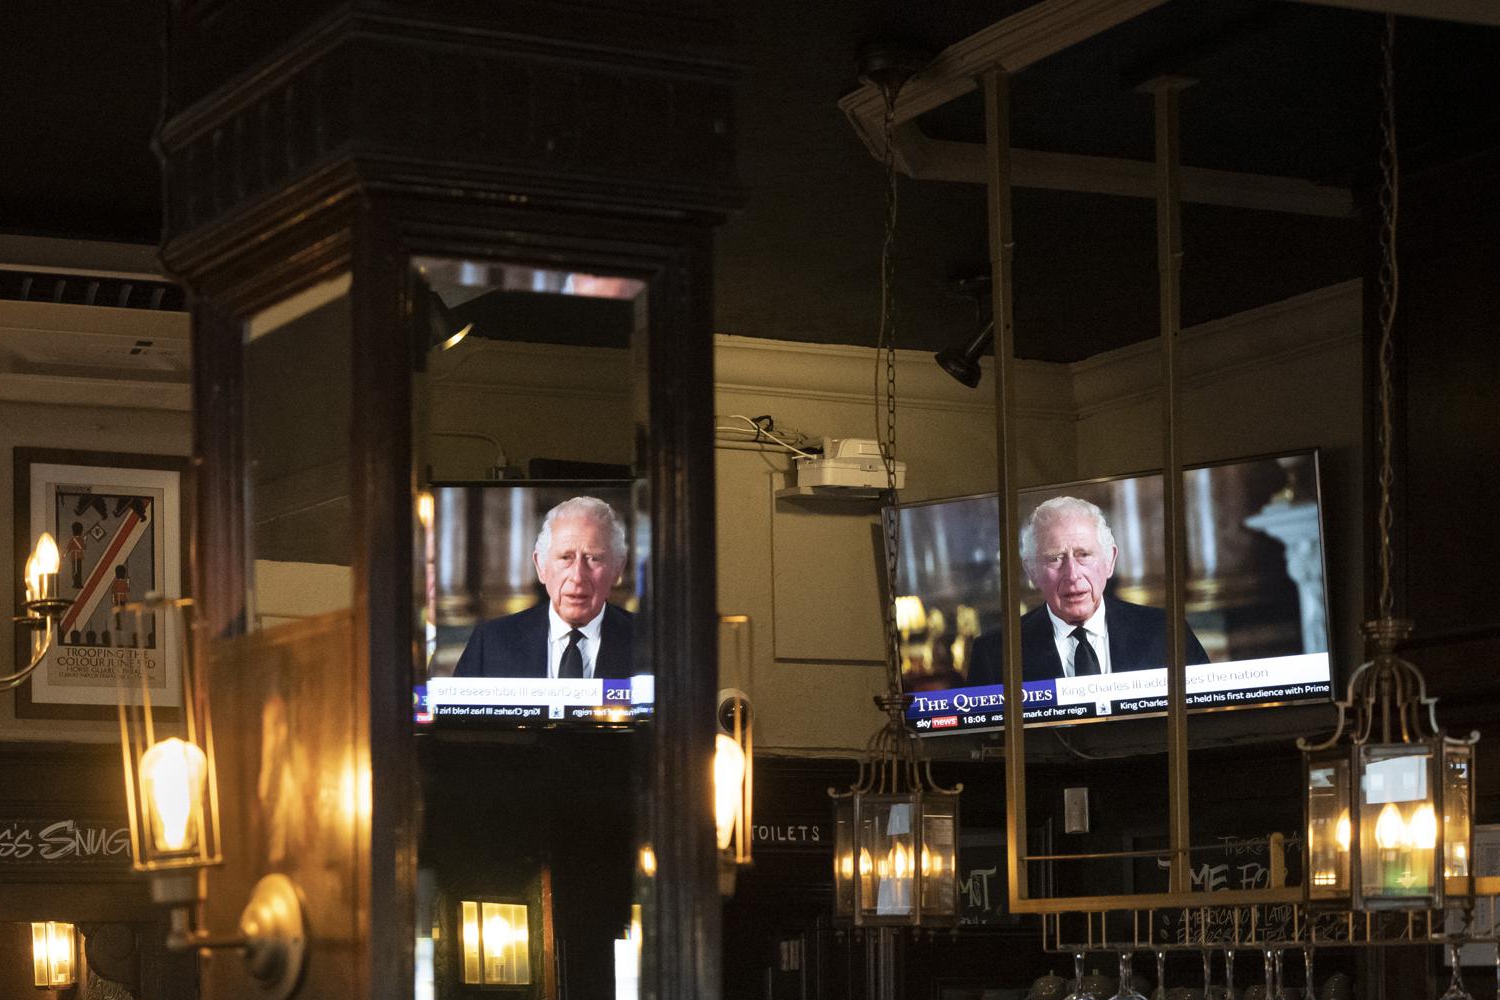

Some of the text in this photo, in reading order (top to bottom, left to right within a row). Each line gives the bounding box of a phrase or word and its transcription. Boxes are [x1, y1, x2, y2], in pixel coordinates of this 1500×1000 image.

[1061, 685, 1086, 698] King
[1087, 681, 1130, 695] Charles
[1207, 670, 1228, 683] the
[1230, 667, 1269, 680] nation
[915, 694, 949, 712] THE
[1120, 700, 1138, 712] King
[1138, 698, 1169, 709] Charles
[1196, 693, 1213, 704] held
[1213, 691, 1226, 702] his
[1227, 689, 1245, 701] first
[1245, 687, 1284, 700] audience
[1285, 685, 1304, 697] with
[1304, 683, 1330, 695] Prime
[963, 714, 987, 725] 18:06
[1052, 706, 1067, 717] her
[1067, 706, 1087, 718] reign
[751, 824, 820, 842] TOILETS
